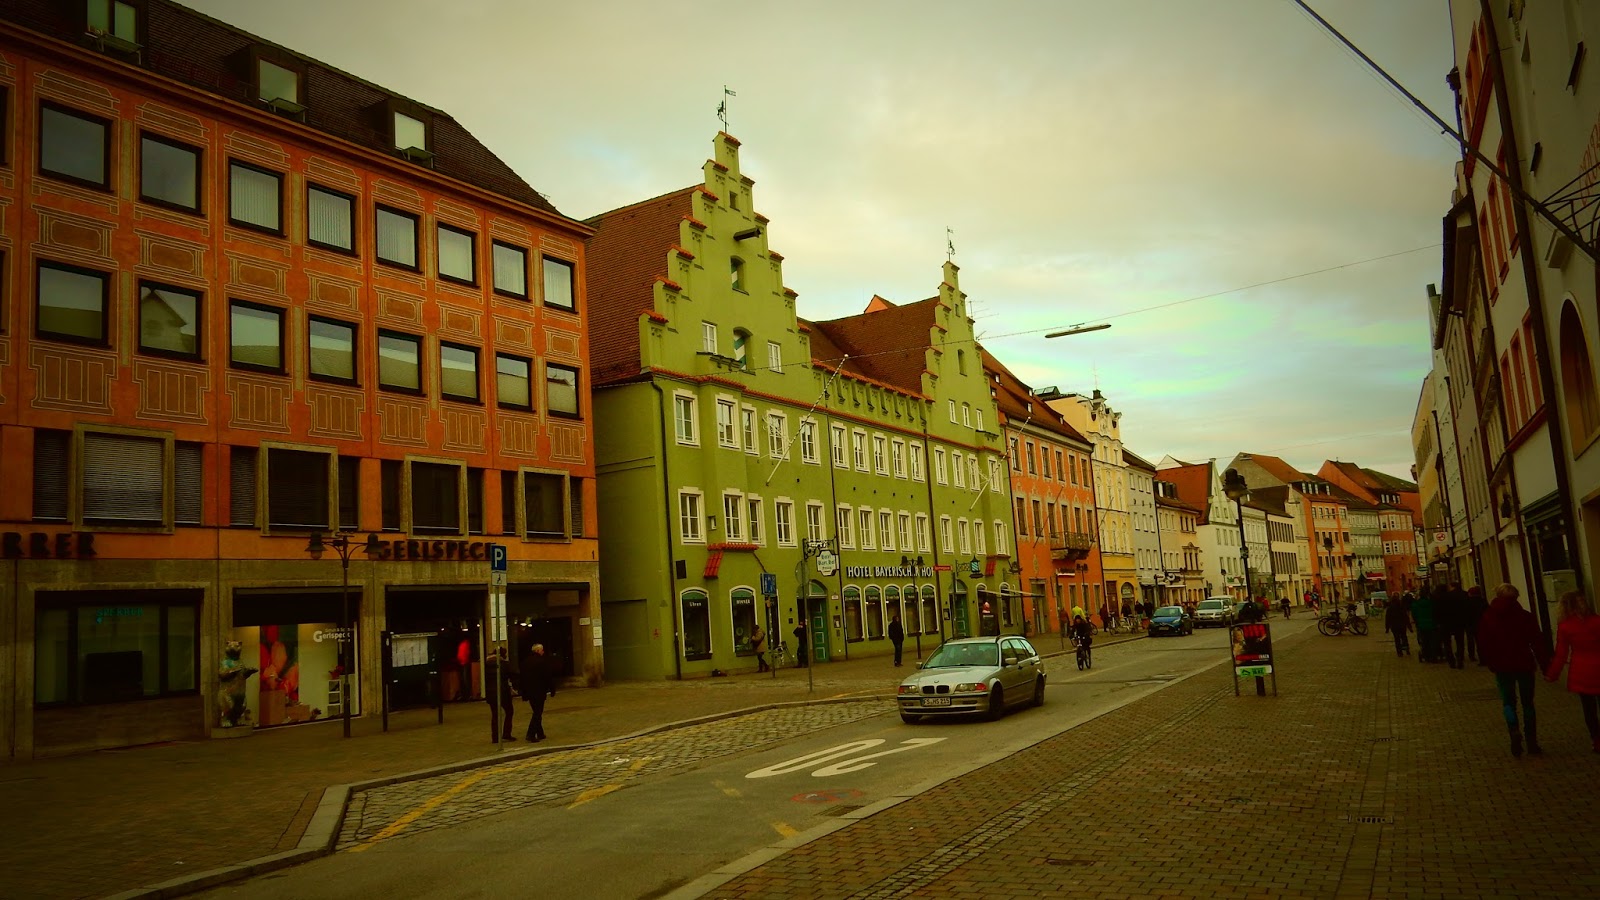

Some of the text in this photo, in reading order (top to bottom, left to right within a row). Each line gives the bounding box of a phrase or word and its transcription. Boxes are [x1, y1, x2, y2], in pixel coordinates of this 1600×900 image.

[3, 532, 97, 558] RRER
[495, 548, 503, 568] P
[847, 566, 873, 578] HOTEL
[874, 566, 920, 578] BAYERISCHR
